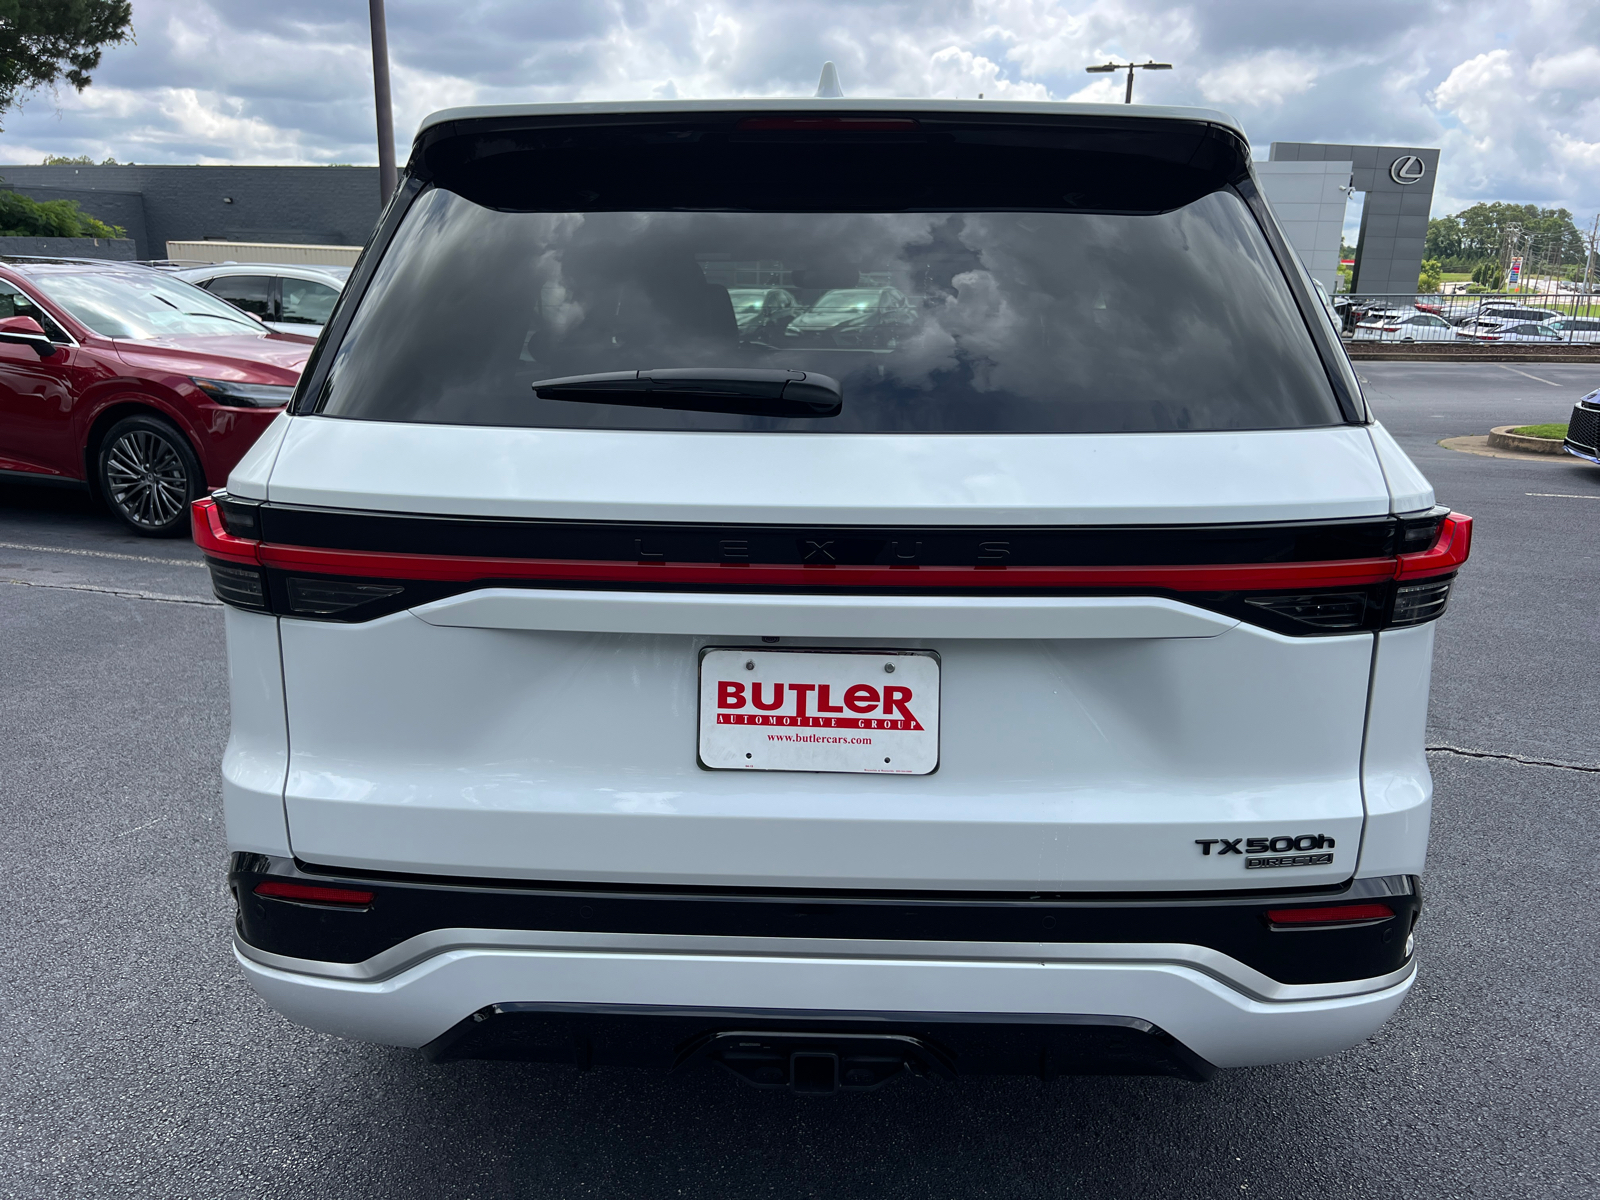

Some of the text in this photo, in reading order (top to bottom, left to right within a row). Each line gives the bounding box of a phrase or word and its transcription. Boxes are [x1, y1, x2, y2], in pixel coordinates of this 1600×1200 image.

[634, 538, 1011, 560] LEXUS
[717, 714, 917, 730] AUTOMOTIVE GROUP
[767, 732, 872, 746] www.butlercars.com
